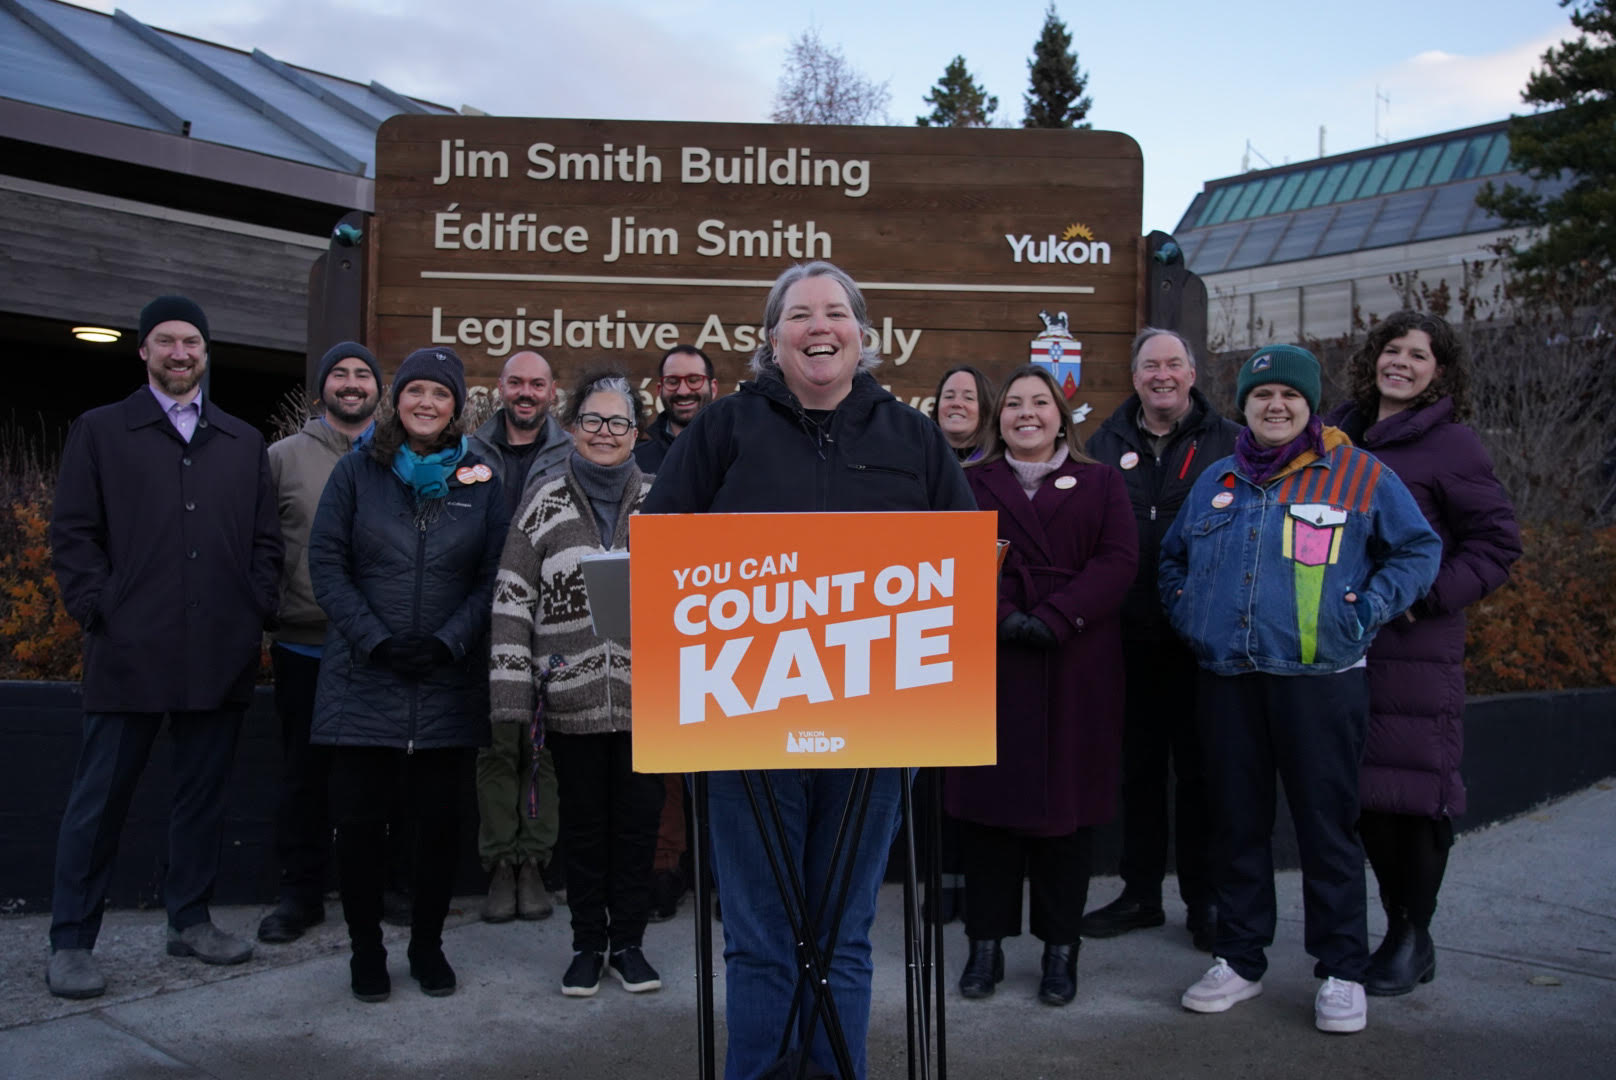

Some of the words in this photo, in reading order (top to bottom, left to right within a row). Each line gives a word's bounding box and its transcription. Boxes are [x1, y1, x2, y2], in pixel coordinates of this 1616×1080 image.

[433, 139, 509, 185] Jim
[527, 142, 662, 183] Smith
[681, 146, 870, 197] Building
[434, 202, 589, 253] Édifice
[603, 216, 679, 262] Jim
[696, 218, 832, 259] Smith
[1004, 233, 1111, 265] Yukon
[431, 307, 680, 357] Legislative
[672, 561, 732, 590] YOU
[739, 551, 799, 580] CAN
[673, 570, 866, 636] COUNT
[873, 557, 955, 607] ON
[678, 604, 954, 726] KATE
[798, 730, 825, 738] YUKON
[798, 736, 846, 753] NDP
